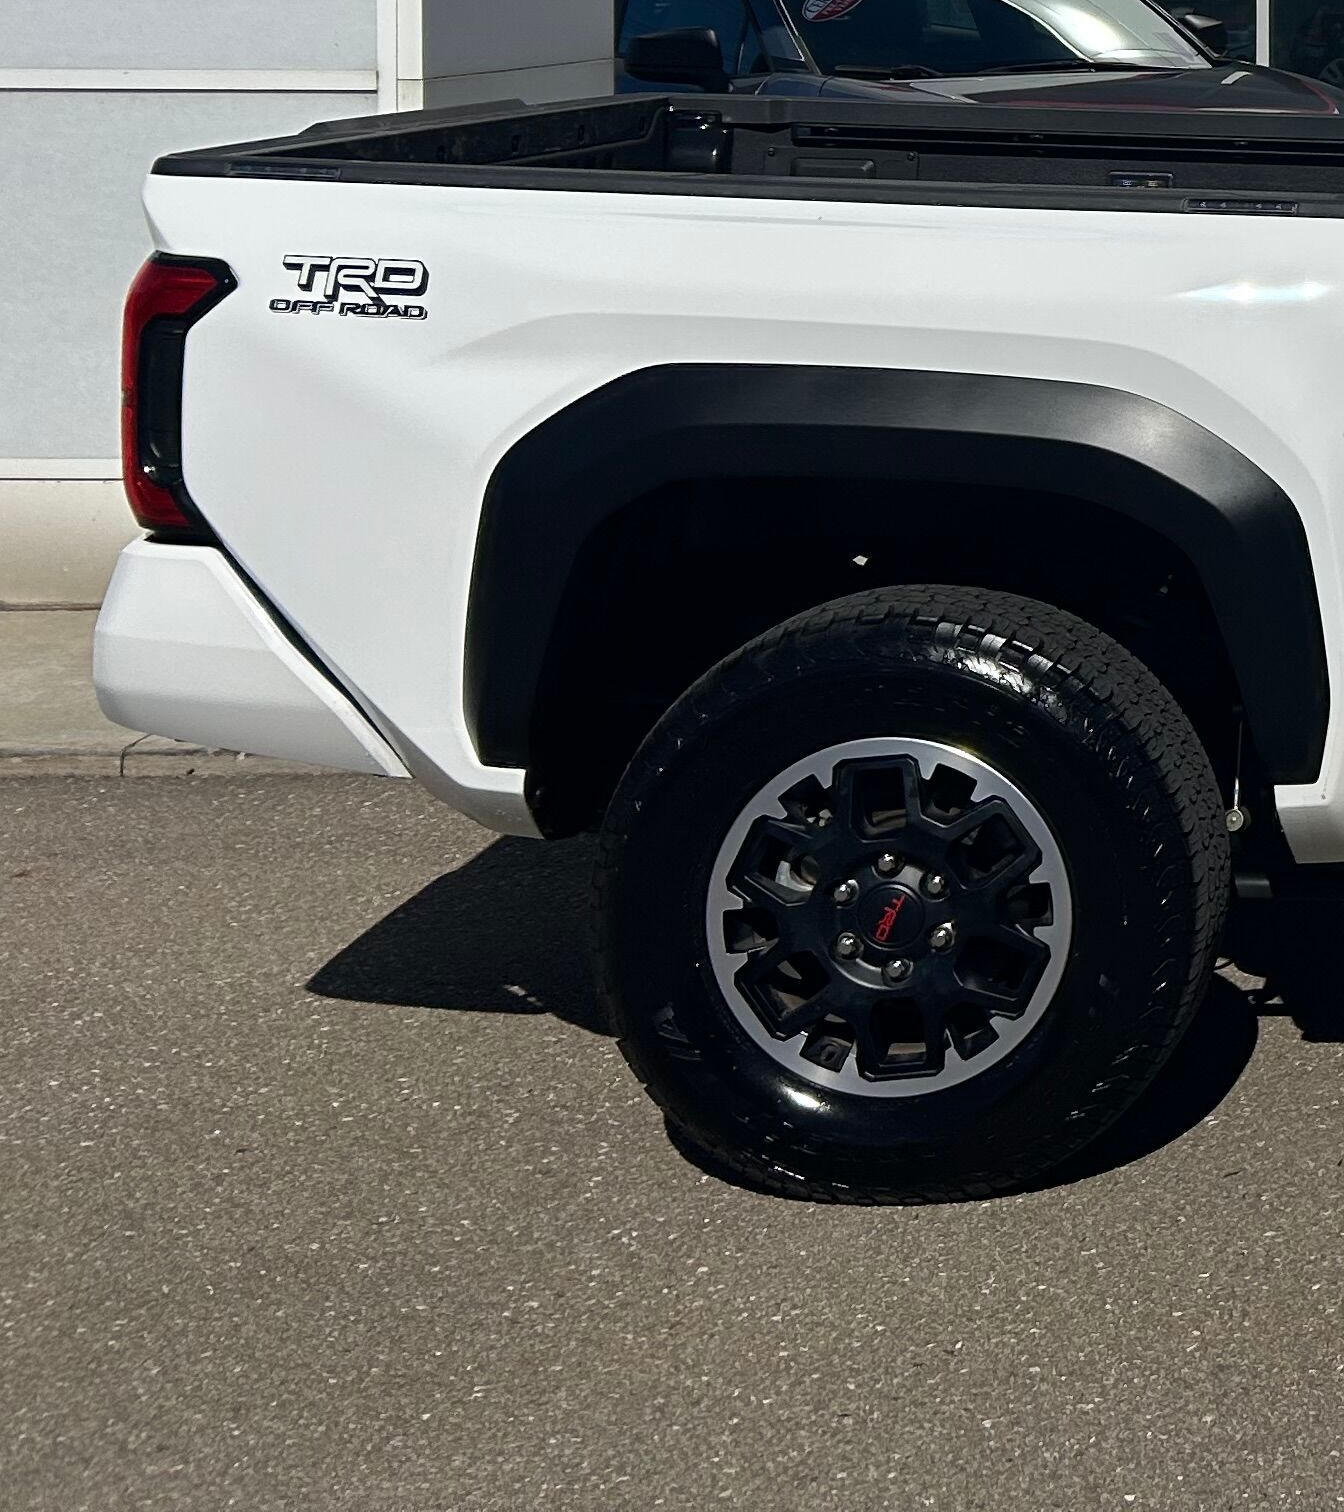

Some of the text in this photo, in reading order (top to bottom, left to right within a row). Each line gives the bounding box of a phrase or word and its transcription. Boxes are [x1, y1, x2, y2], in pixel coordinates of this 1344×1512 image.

[283, 254, 430, 303] TRD
[268, 298, 428, 320] OFF ROAD
[874, 892, 907, 942] TRD
